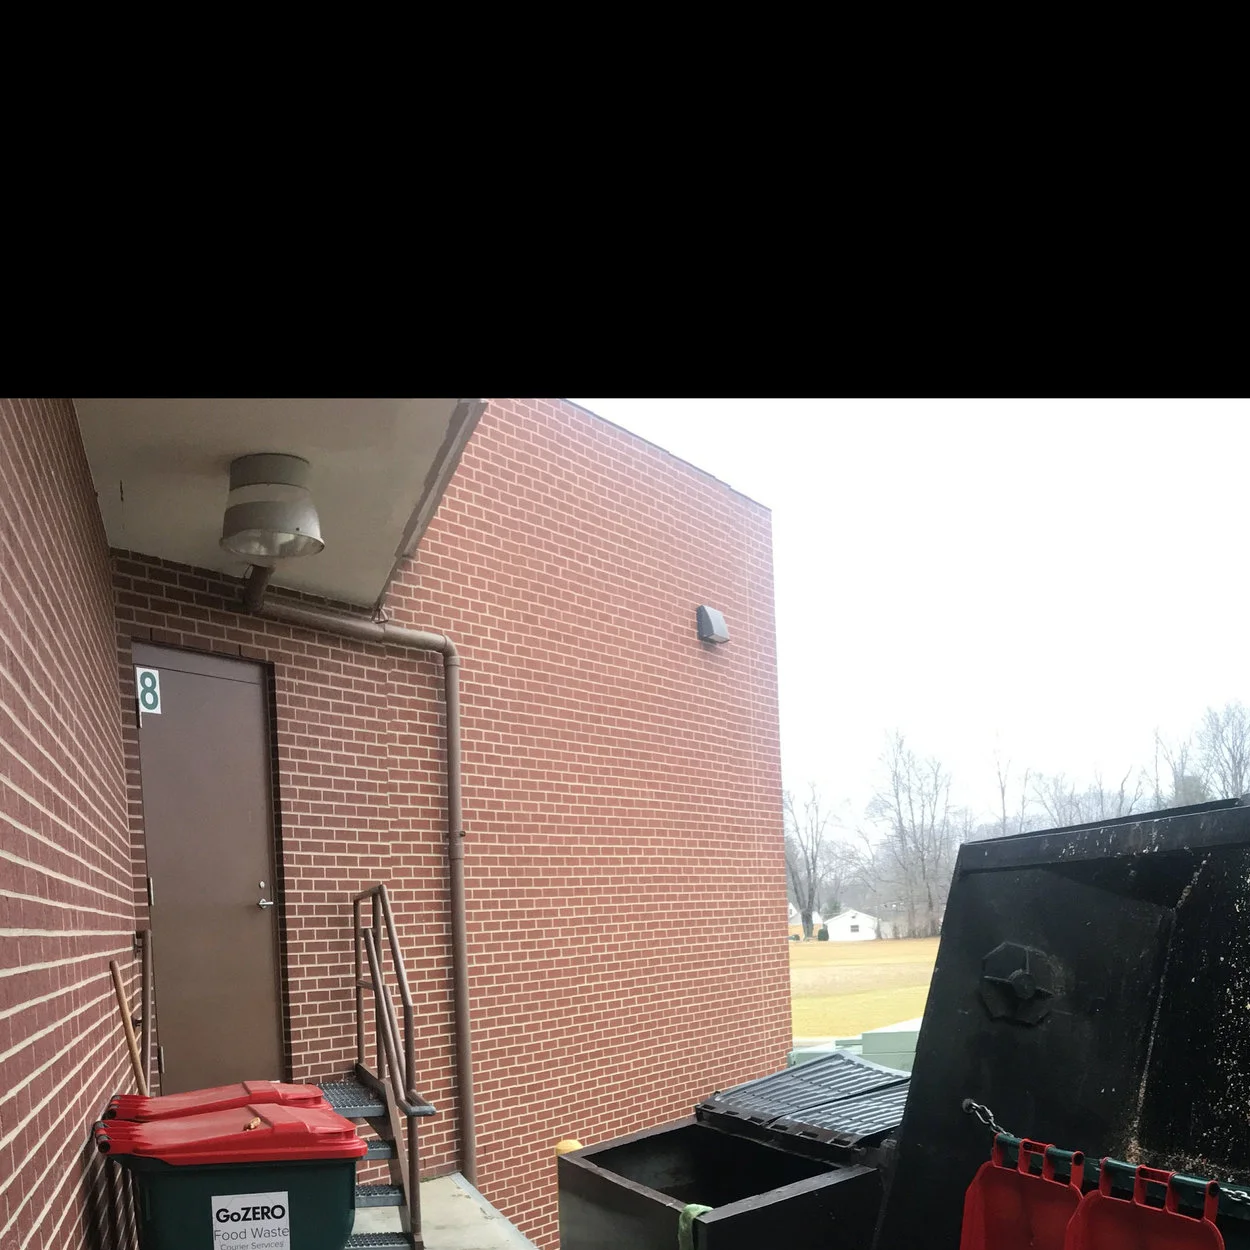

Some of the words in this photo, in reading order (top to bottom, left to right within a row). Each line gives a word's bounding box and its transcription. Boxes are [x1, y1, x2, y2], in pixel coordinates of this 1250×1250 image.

[140, 671, 159, 710] 8
[216, 1204, 286, 1223] GoZERO
[214, 1228, 247, 1241] Food
[251, 1227, 290, 1239] Waste
[251, 1241, 284, 1250] Services
